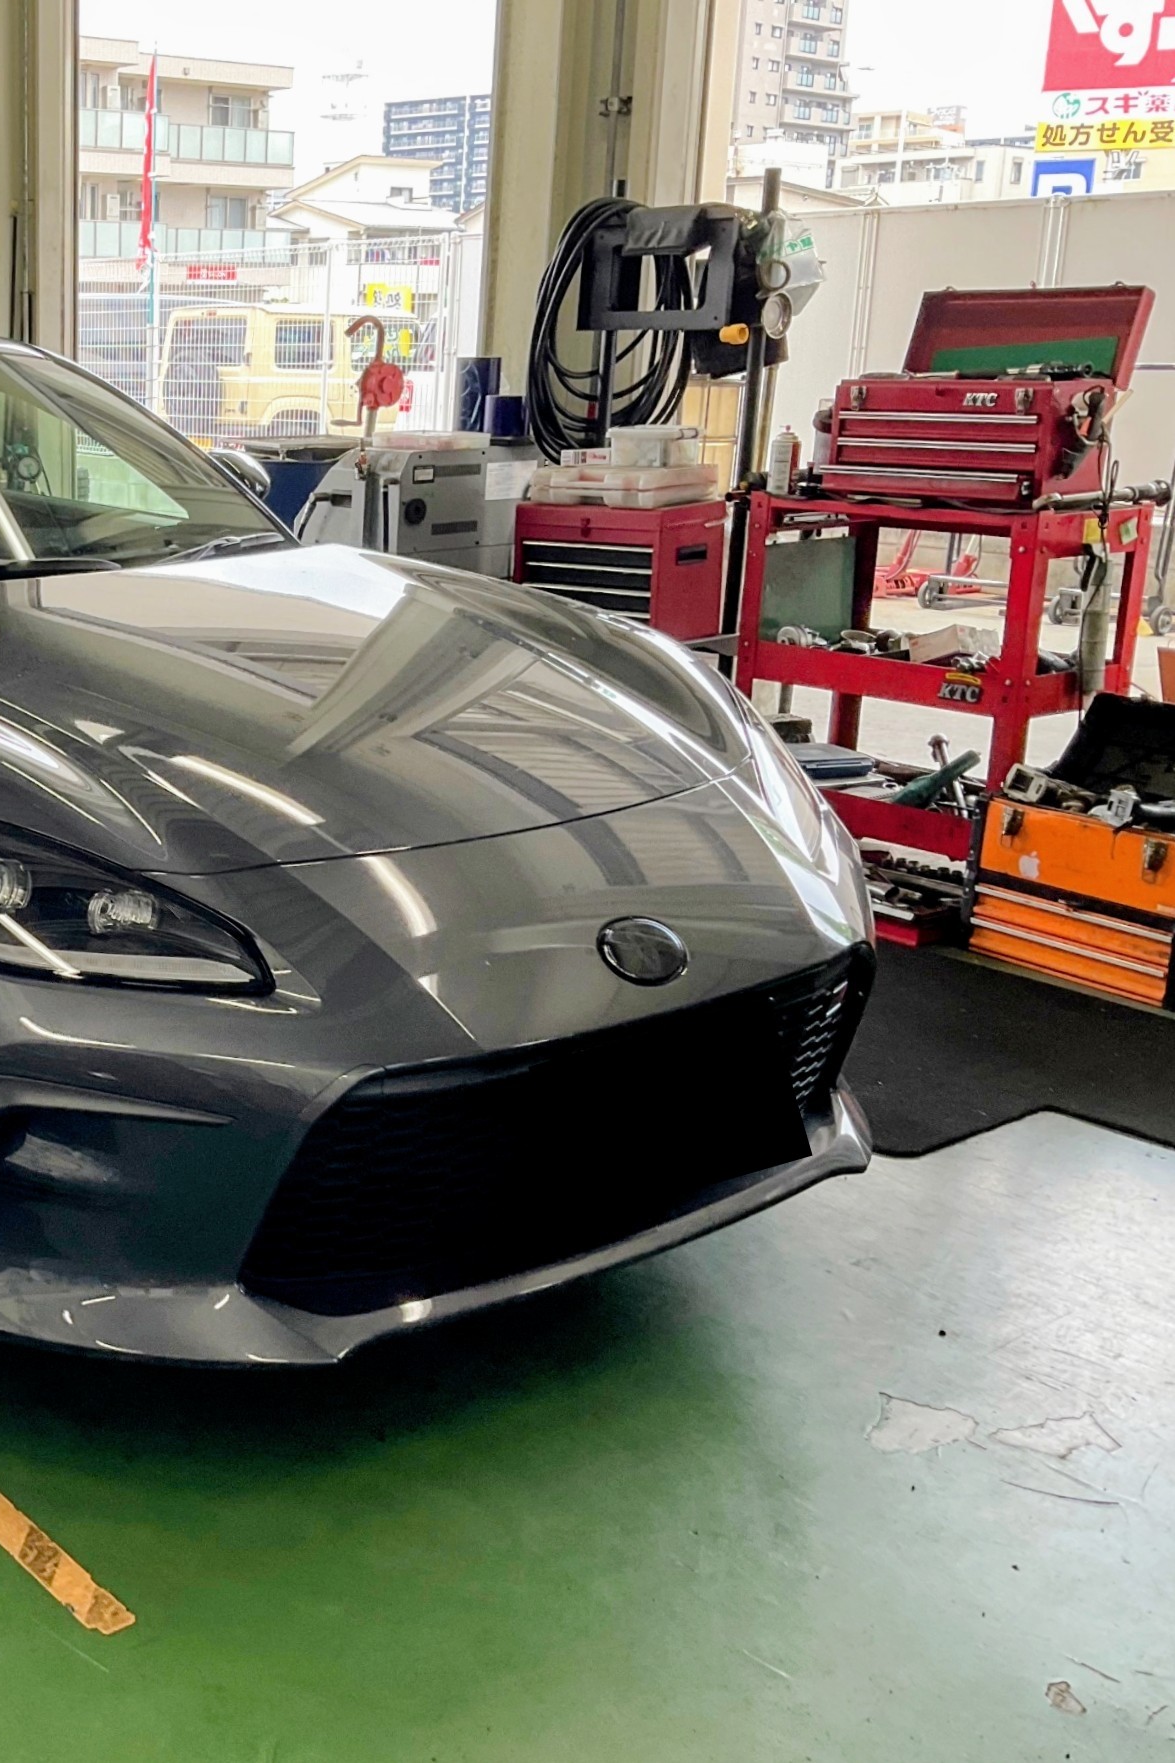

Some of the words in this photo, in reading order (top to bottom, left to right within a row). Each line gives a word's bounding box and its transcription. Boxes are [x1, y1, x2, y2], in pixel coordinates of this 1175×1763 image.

[1085, 90, 1175, 115] スギ薬
[1041, 120, 1174, 147] 処方せん受
[962, 392, 998, 407] KTC
[937, 682, 980, 703] KTC
